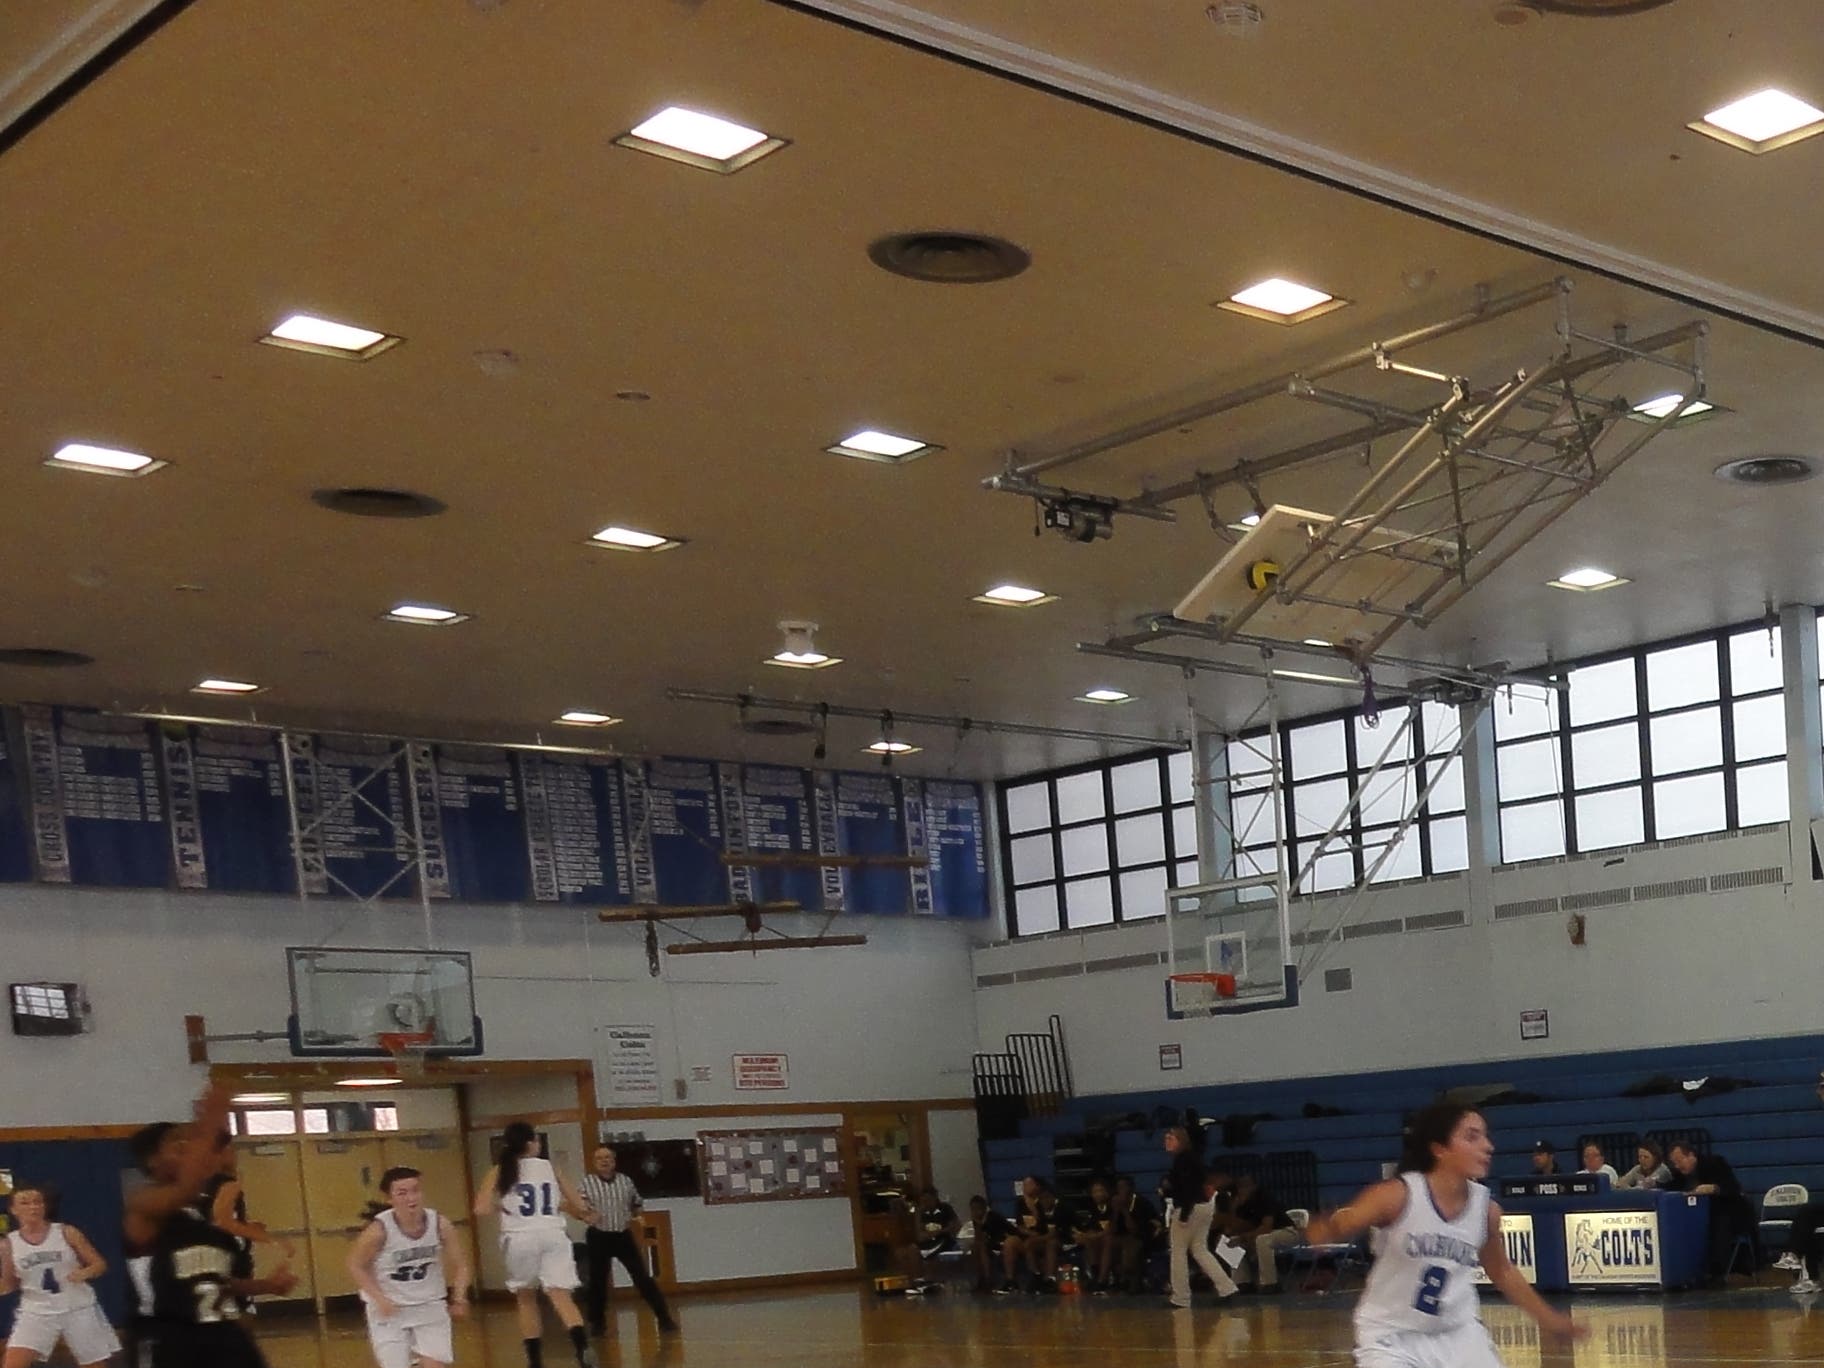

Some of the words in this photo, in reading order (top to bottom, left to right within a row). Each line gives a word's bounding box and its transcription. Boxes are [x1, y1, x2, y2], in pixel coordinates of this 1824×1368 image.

[31, 734, 55, 805] COUNTRY
[167, 746, 200, 867] TENNIS
[38, 812, 65, 862] CROSS
[723, 786, 750, 901] BADINTON
[518, 1182, 552, 1217] 31
[1602, 1216, 1623, 1225] HOME
[1624, 1216, 1632, 1224] OF
[1634, 1215, 1649, 1223] THE
[1601, 1229, 1654, 1266] COLTS
[42, 1267, 61, 1294] 4
[1414, 1265, 1448, 1316] 2
